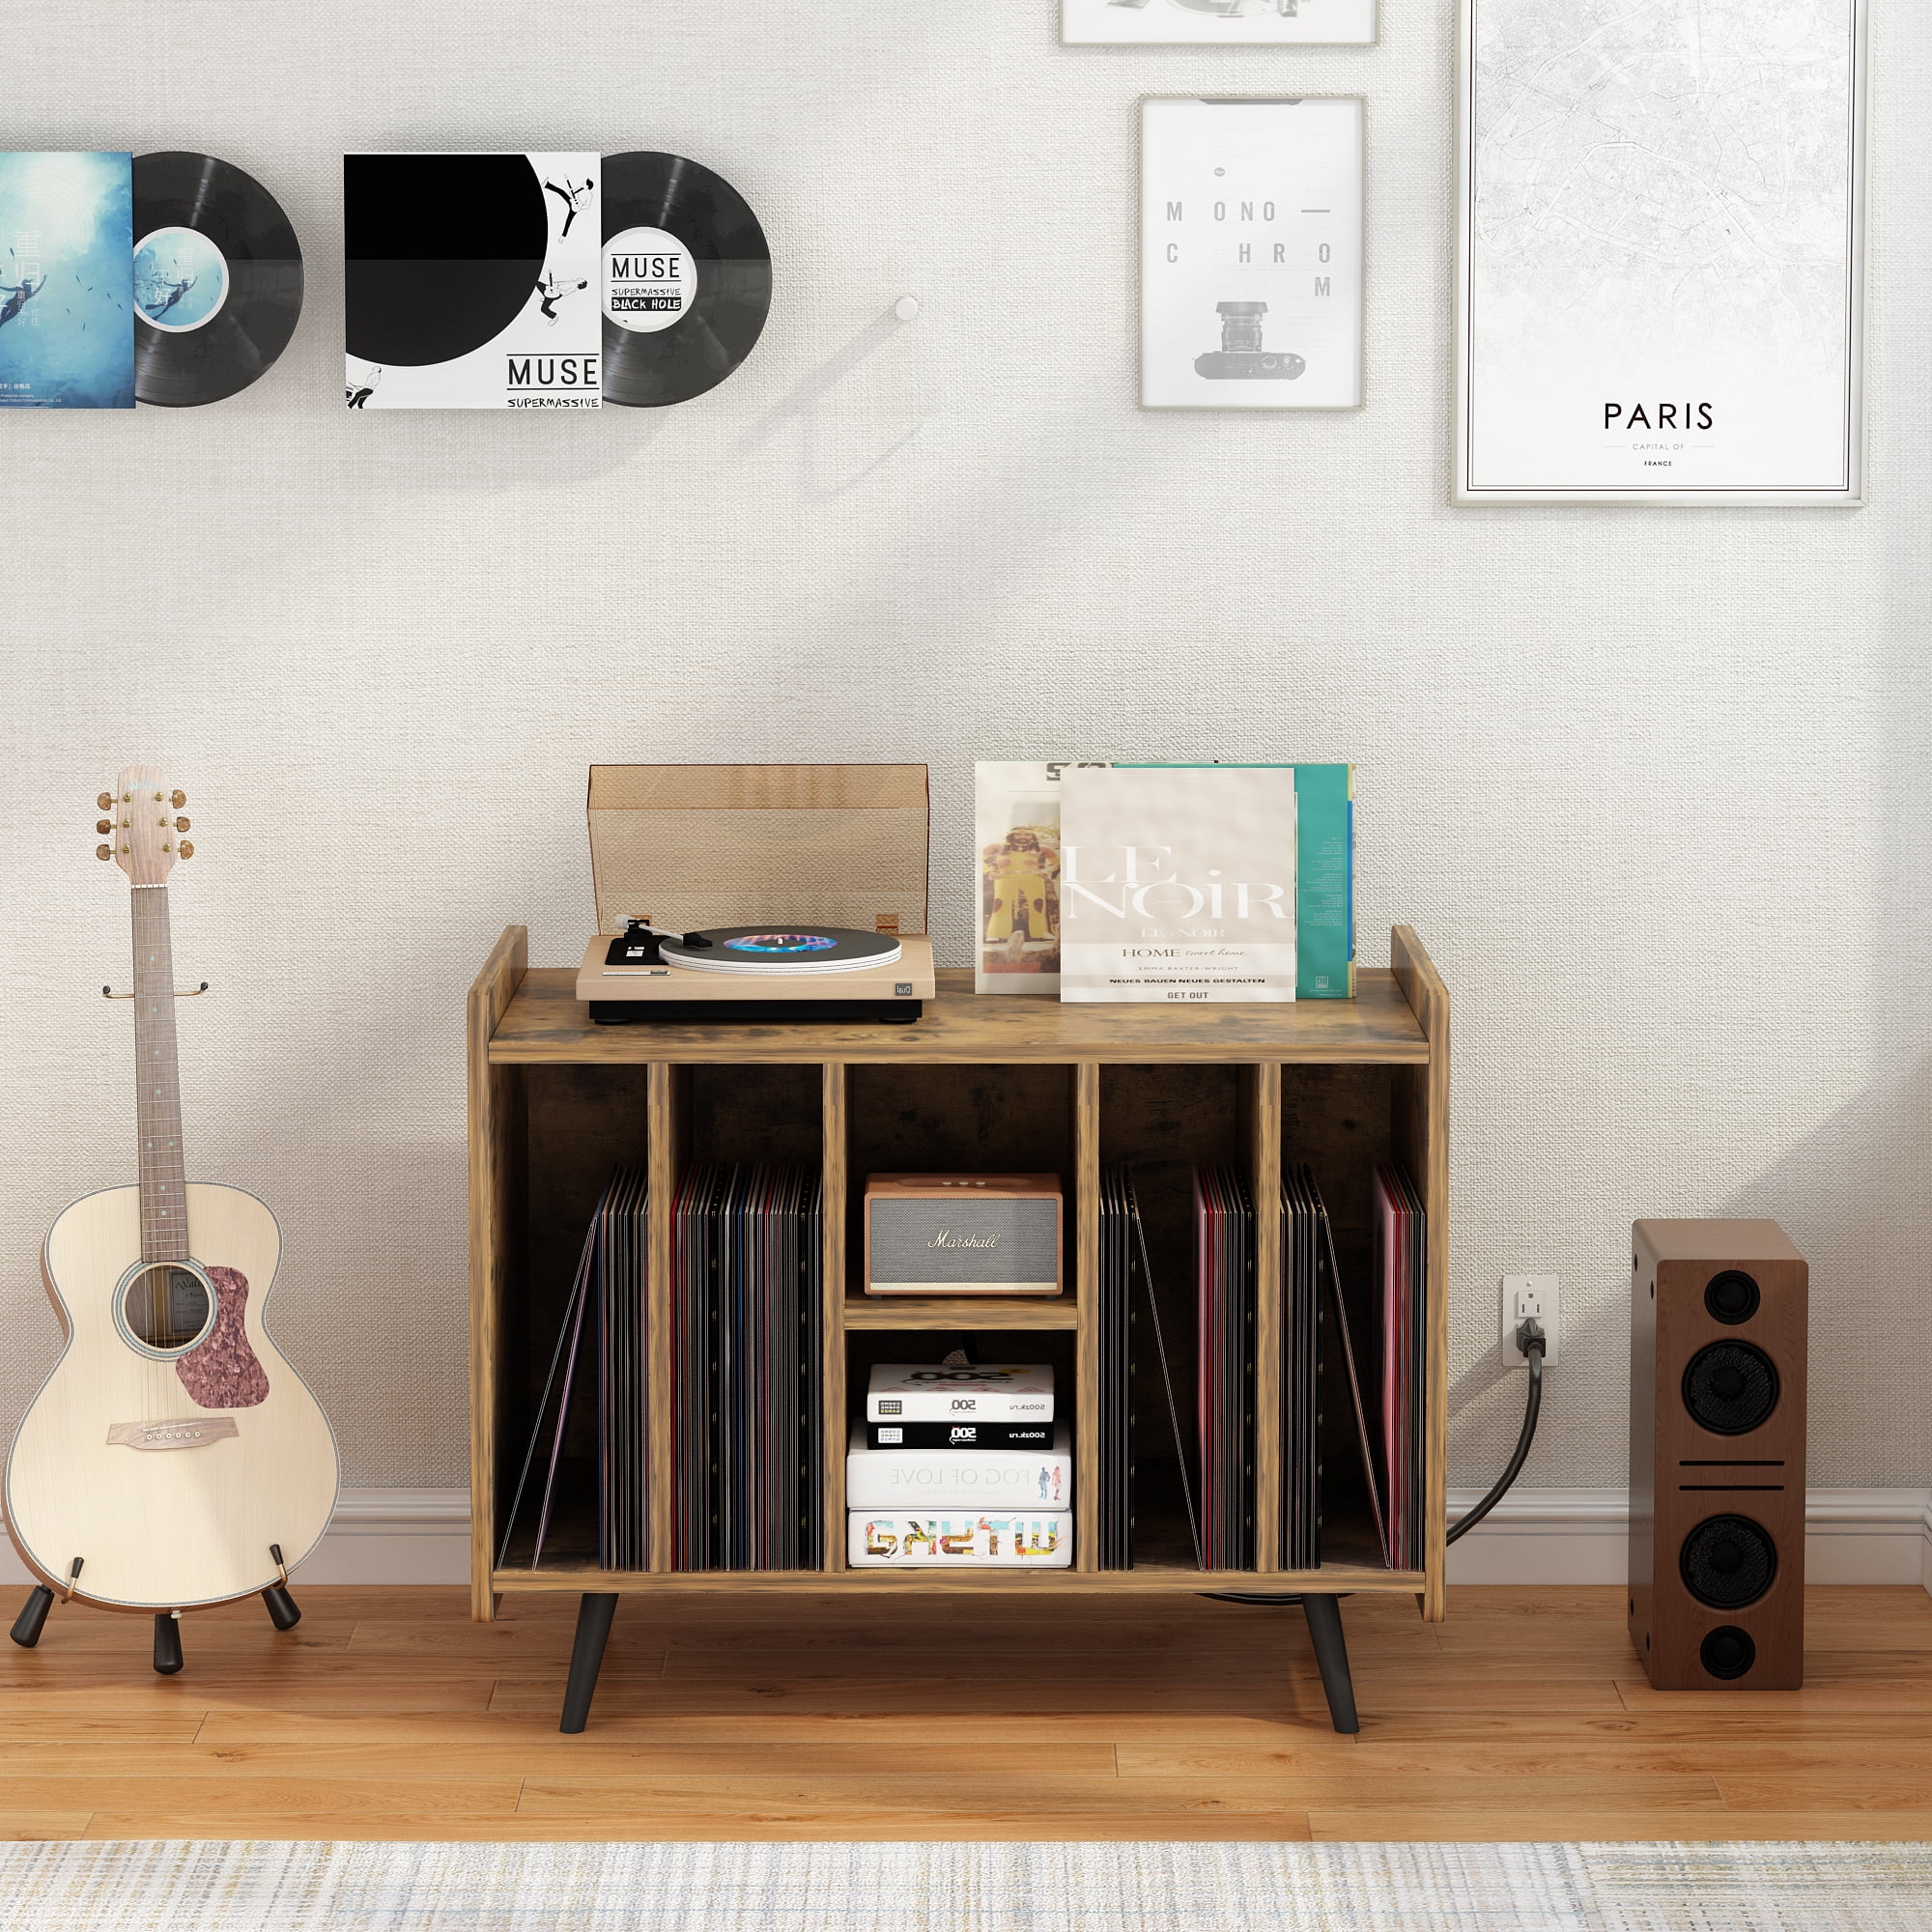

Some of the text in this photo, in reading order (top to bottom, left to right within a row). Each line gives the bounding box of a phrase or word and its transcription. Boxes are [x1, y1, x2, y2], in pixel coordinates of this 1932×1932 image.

[611, 257, 681, 278] MUSE
[611, 298, 681, 310] BLACK HOLE
[507, 358, 598, 385] MUSE
[1605, 402, 1713, 430] PARIS
[1063, 845, 1177, 883] LE
[1122, 949, 1180, 957] HOME
[927, 1229, 1001, 1248] Marshall
